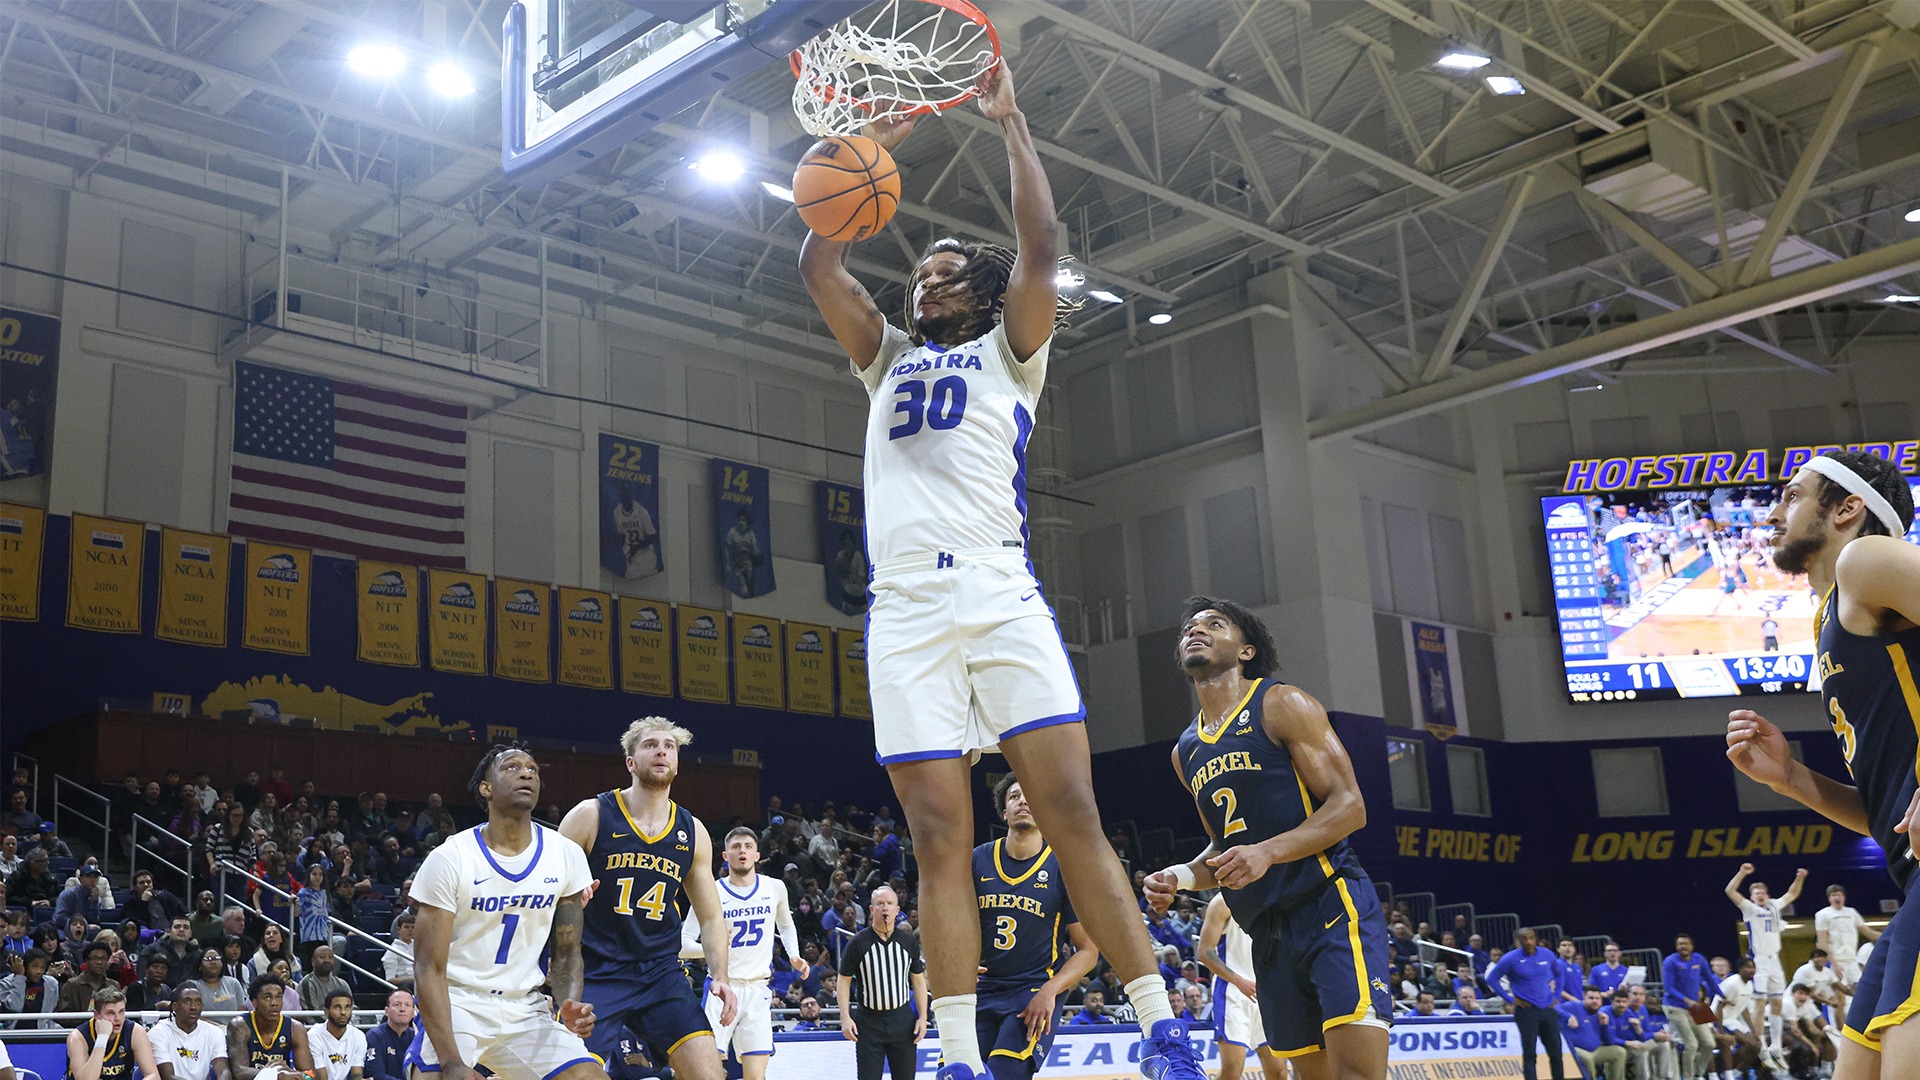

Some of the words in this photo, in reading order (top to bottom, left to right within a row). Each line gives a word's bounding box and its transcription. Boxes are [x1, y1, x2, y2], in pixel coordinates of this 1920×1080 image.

[888, 375, 968, 441] 30
[609, 442, 642, 472] 22
[1563, 449, 1769, 492] HOFSTRA
[1778, 440, 1920, 481] PDE
[606, 467, 653, 485] JENKINS
[723, 466, 750, 493] 14
[828, 488, 851, 513] 15
[86, 550, 128, 566] NCAA
[937, 552, 954, 569] H
[175, 563, 216, 580] NCAA
[259, 567, 299, 581] HOFSTRA
[263, 585, 294, 600] NIT
[372, 584, 407, 595] HOFSTRA
[375, 601, 403, 613] NIT
[441, 594, 476, 606] HOFSTRA
[506, 601, 540, 613] HOFSTRA
[439, 610, 478, 625] WNIT
[570, 610, 603, 621] HOFSTRA
[378, 622, 399, 632] 2006
[510, 619, 537, 632] NIT
[631, 619, 662, 630] HOFSTRA
[448, 631, 469, 641] 2006
[567, 626, 605, 640] WNIT
[688, 628, 718, 638] HOFSTRA
[630, 635, 663, 648] WNIT
[1566, 644, 1584, 654] AST
[687, 643, 719, 656] WNIT
[743, 650, 773, 663] WNIT
[799, 658, 820, 669] NIT
[1733, 655, 1805, 680] 13:40
[1567, 672, 1601, 682] FOULS
[1602, 671, 1611, 682] 2
[1627, 663, 1661, 688] 11
[1569, 681, 1604, 692] BONUS
[1760, 682, 1782, 692] 1ST
[160, 697, 184, 710] 110
[738, 751, 753, 762] 112
[1191, 751, 1262, 799] DREXEL
[1211, 787, 1249, 839] 2
[675, 844, 689, 852] CAA
[1425, 828, 1491, 861] PRIDE
[1494, 833, 1522, 863] OF
[1571, 830, 1676, 863] LONG
[1686, 824, 1833, 859] ISLAND
[605, 852, 682, 883] DREXEL
[471, 894, 556, 912] HOFSTRA
[613, 876, 667, 921] 14
[978, 893, 1046, 918] DREXEL
[723, 905, 771, 919] HOFSTRA
[494, 913, 520, 965] 1
[731, 918, 765, 948] 25
[993, 915, 1018, 951] 3
[1388, 1063, 1430, 1080] MORE
[1431, 1059, 1525, 1079] INFORMATION
